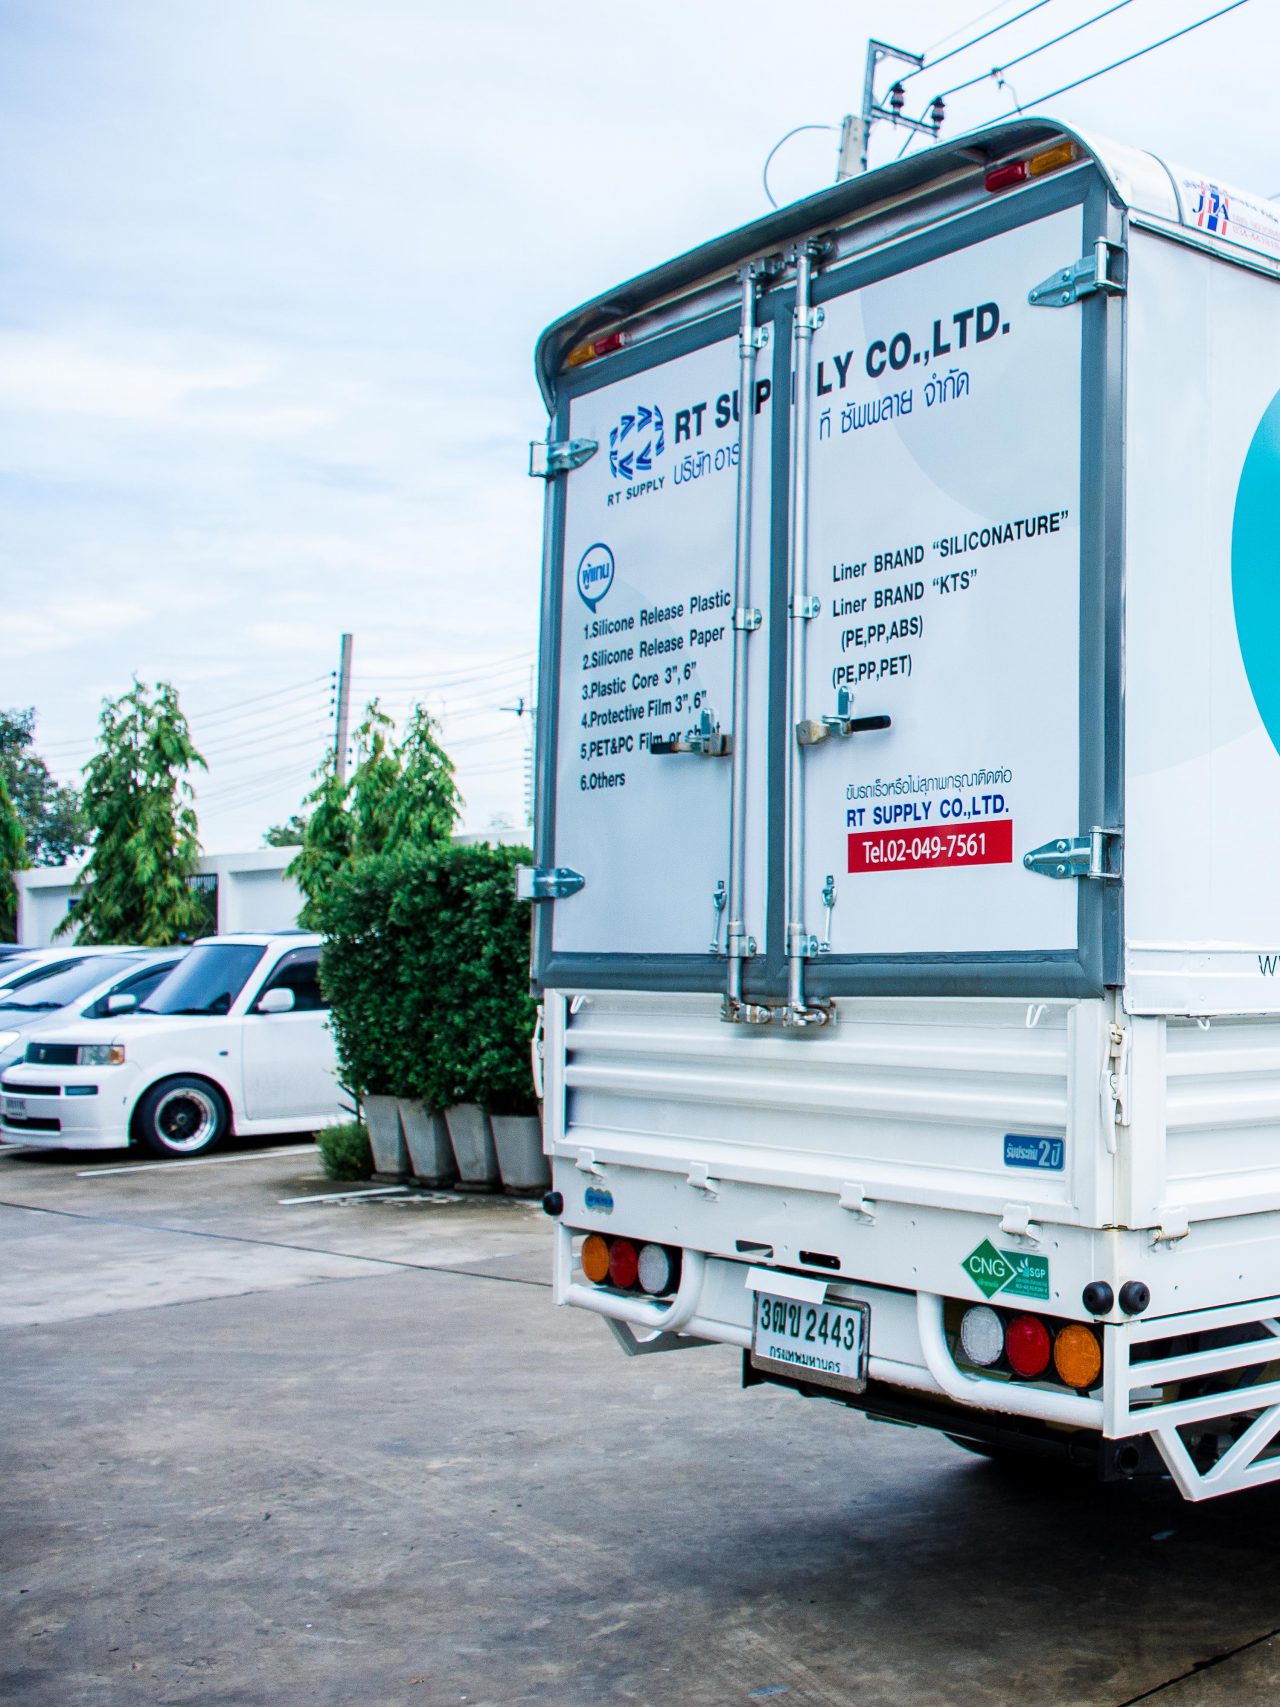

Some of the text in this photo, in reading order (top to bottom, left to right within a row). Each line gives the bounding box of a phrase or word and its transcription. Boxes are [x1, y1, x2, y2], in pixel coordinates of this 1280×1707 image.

[674, 402, 707, 444] RT
[866, 302, 1010, 378] CO.,LTD.
[673, 451, 711, 485] บริษัท
[819, 408, 831, 440] ที
[841, 389, 913, 434] ซัพพลาย
[924, 368, 970, 407] จำกัด
[607, 476, 665, 506] RT SUPPLY
[832, 510, 1069, 583] Liner BRAND “SILICONATURE”
[832, 569, 978, 618] Liner BRAND “KTS”
[584, 590, 731, 640] 1.Silicone Release Plastic
[582, 627, 725, 671] 2.Silicone Release Paper
[841, 615, 924, 652] (PE,PP,ABS)
[582, 677, 626, 700] 3.Plastic
[632, 673, 659, 691] Core
[832, 654, 912, 689] (PE,PP,PET)
[581, 704, 644, 729] 4.Protective
[648, 699, 672, 717] Film
[580, 771, 626, 791] 6.Others
[846, 766, 1012, 800] ขับรถเร็วหรือไม่สุภาพกรุณาติดต่อ
[846, 794, 1009, 827] RT SUPPLY CO.,LTD.
[862, 832, 986, 864] Tel.02-049-7561
[1038, 1140, 1050, 1167] 2
[1051, 1142, 1062, 1166] ปี
[969, 1255, 1006, 1277] CNG
[1029, 1267, 1046, 1278] SGP
[805, 1309, 855, 1350] 2443
[770, 1346, 840, 1373] กรงเทพมหานคร
